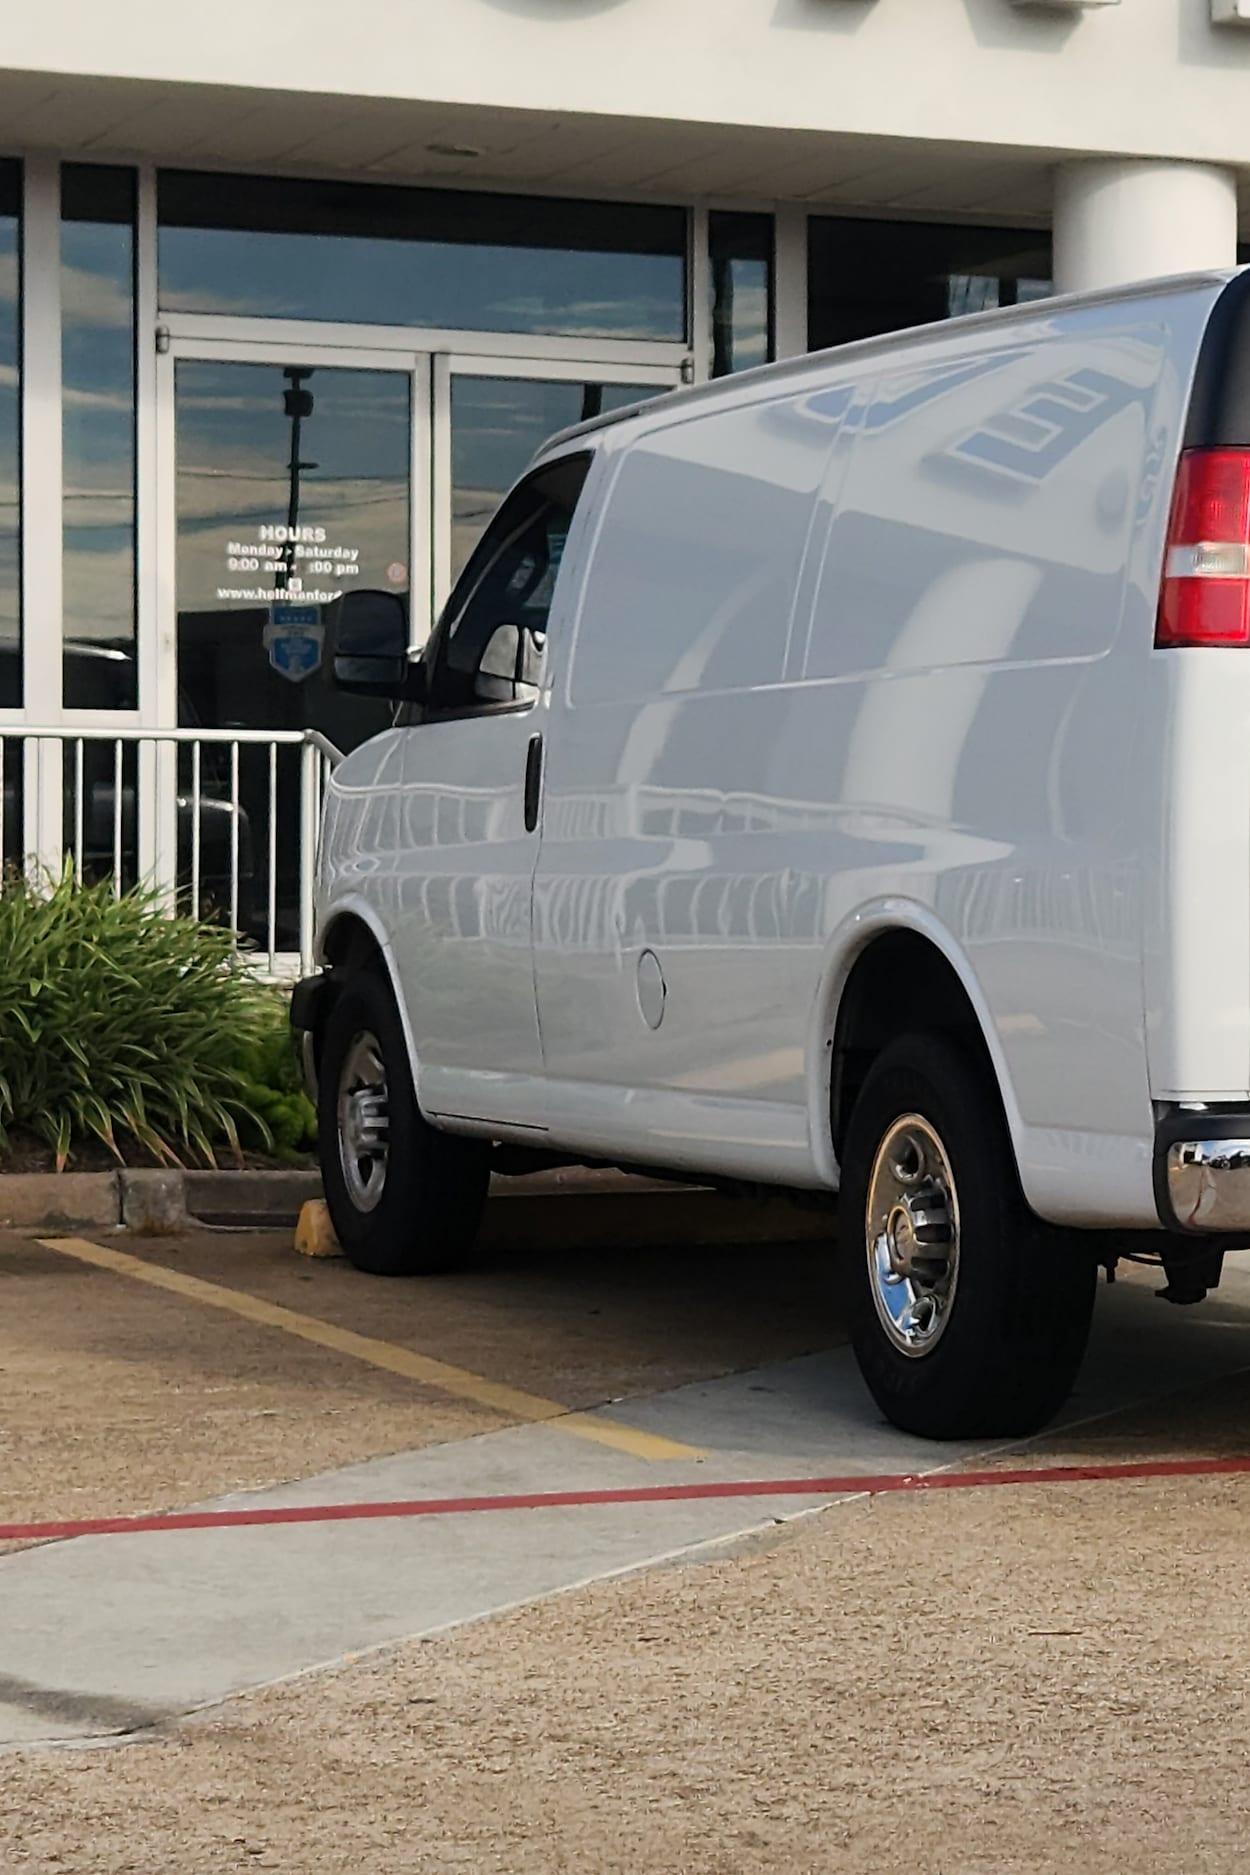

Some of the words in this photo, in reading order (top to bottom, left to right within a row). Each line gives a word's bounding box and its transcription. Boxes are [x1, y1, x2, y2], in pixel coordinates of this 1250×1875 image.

[260, 525, 326, 542] HOURS
[227, 541, 283, 559] Monday
[294, 544, 359, 561] Saturday
[264, 561, 287, 572] am
[335, 563, 359, 576] pm
